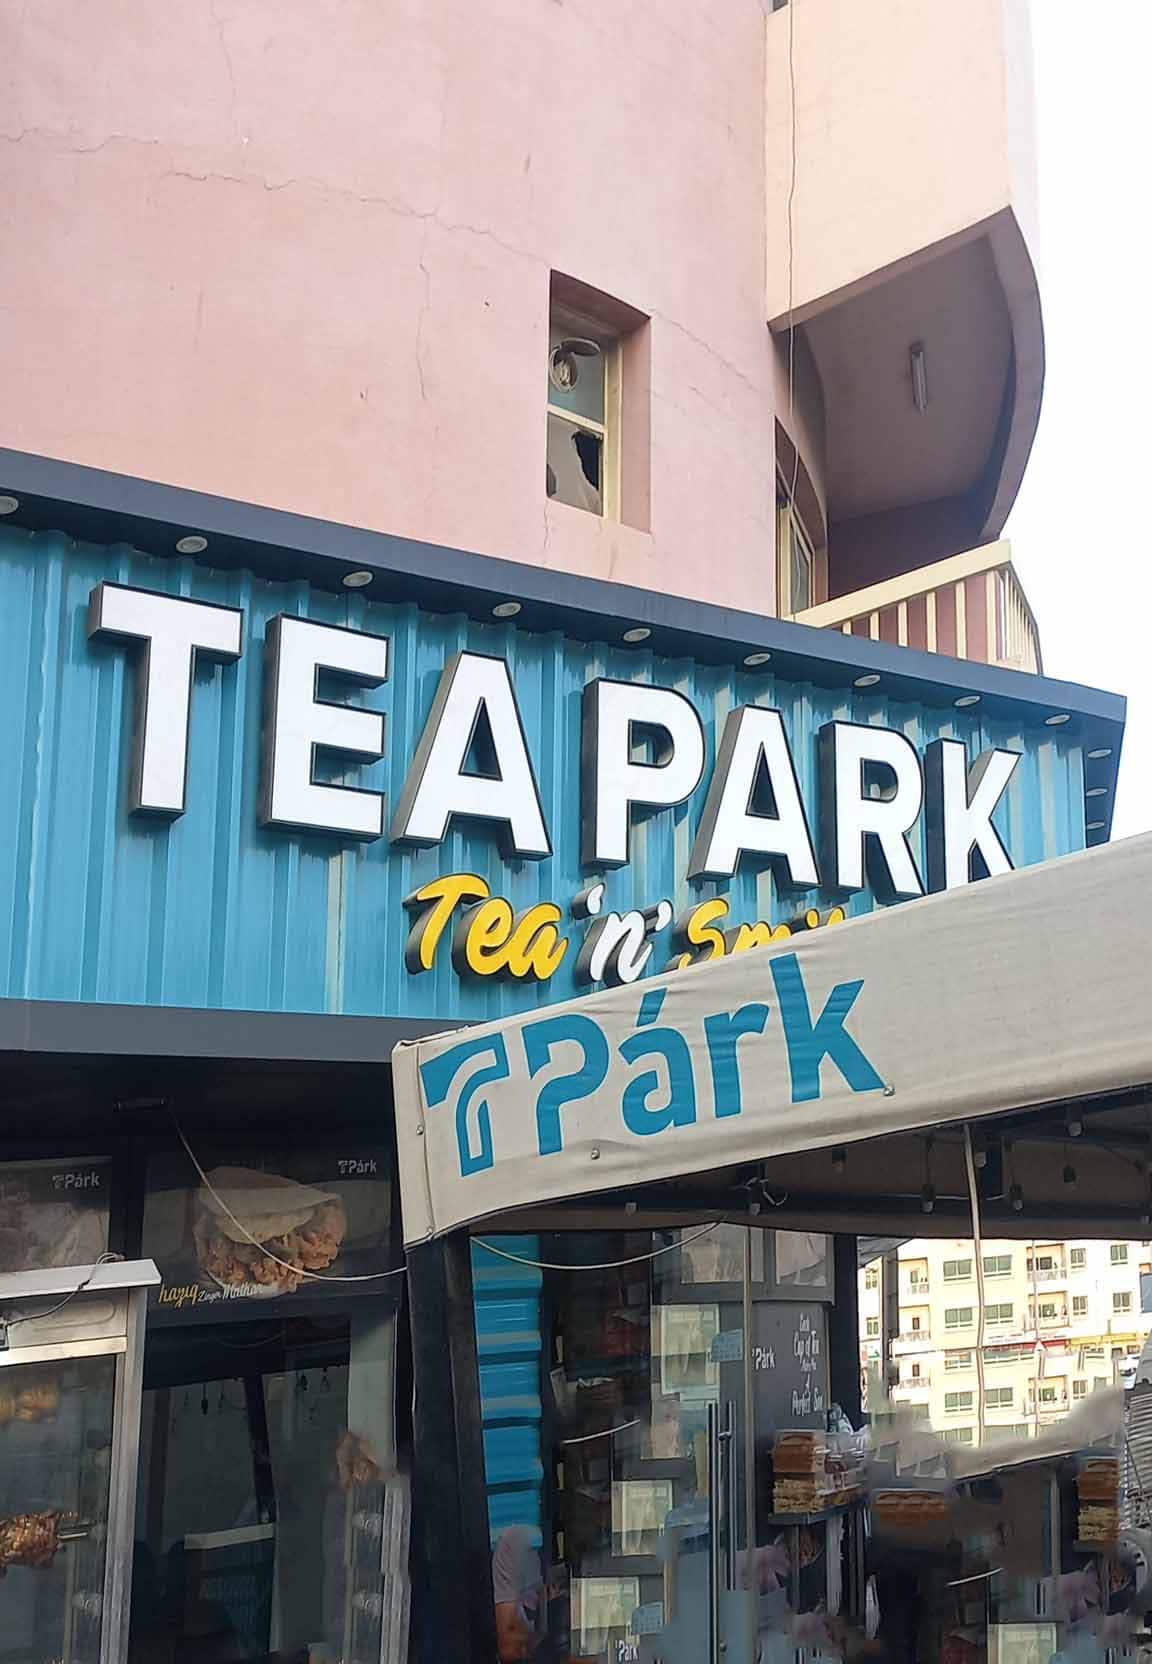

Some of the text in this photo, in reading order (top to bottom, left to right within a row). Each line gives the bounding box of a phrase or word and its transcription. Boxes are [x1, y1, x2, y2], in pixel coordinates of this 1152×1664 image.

[89, 581, 1022, 896] TEA PARK
[404, 872, 569, 983] Tea
